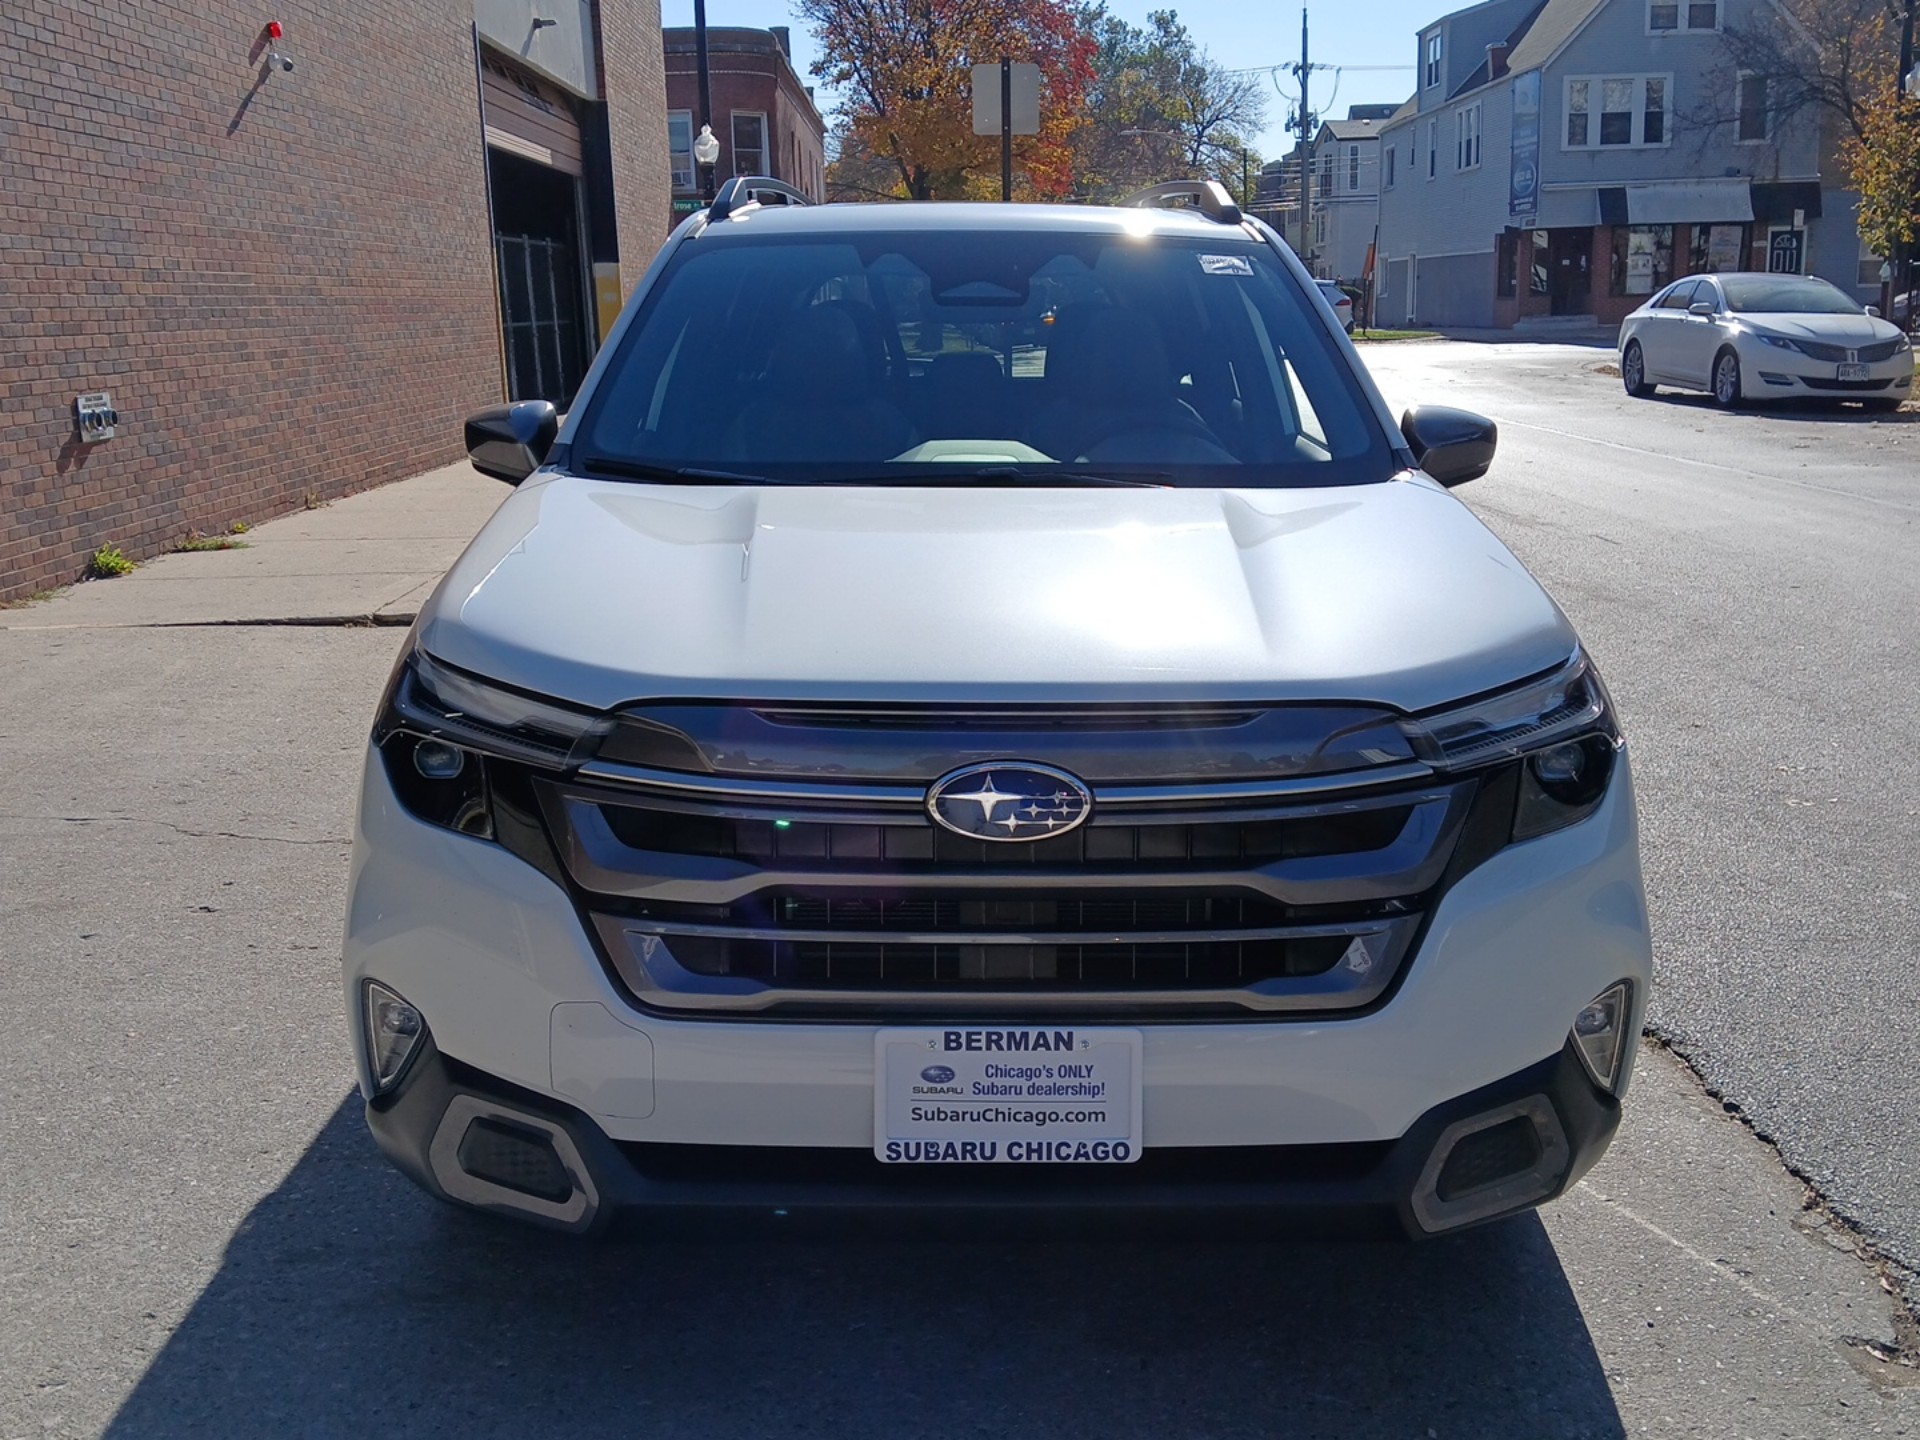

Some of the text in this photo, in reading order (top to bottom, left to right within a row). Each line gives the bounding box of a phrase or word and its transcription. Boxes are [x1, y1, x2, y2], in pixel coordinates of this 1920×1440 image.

[944, 1031, 1074, 1051] BERMAN
[985, 1064, 1094, 1081] Chicago's ONLY
[912, 1086, 964, 1094] SUBARU
[972, 1081, 1105, 1098] Subaru dealership!
[911, 1107, 1106, 1126] SubaruChicago.com
[886, 1141, 1131, 1161] SUBARU CHICAGO
